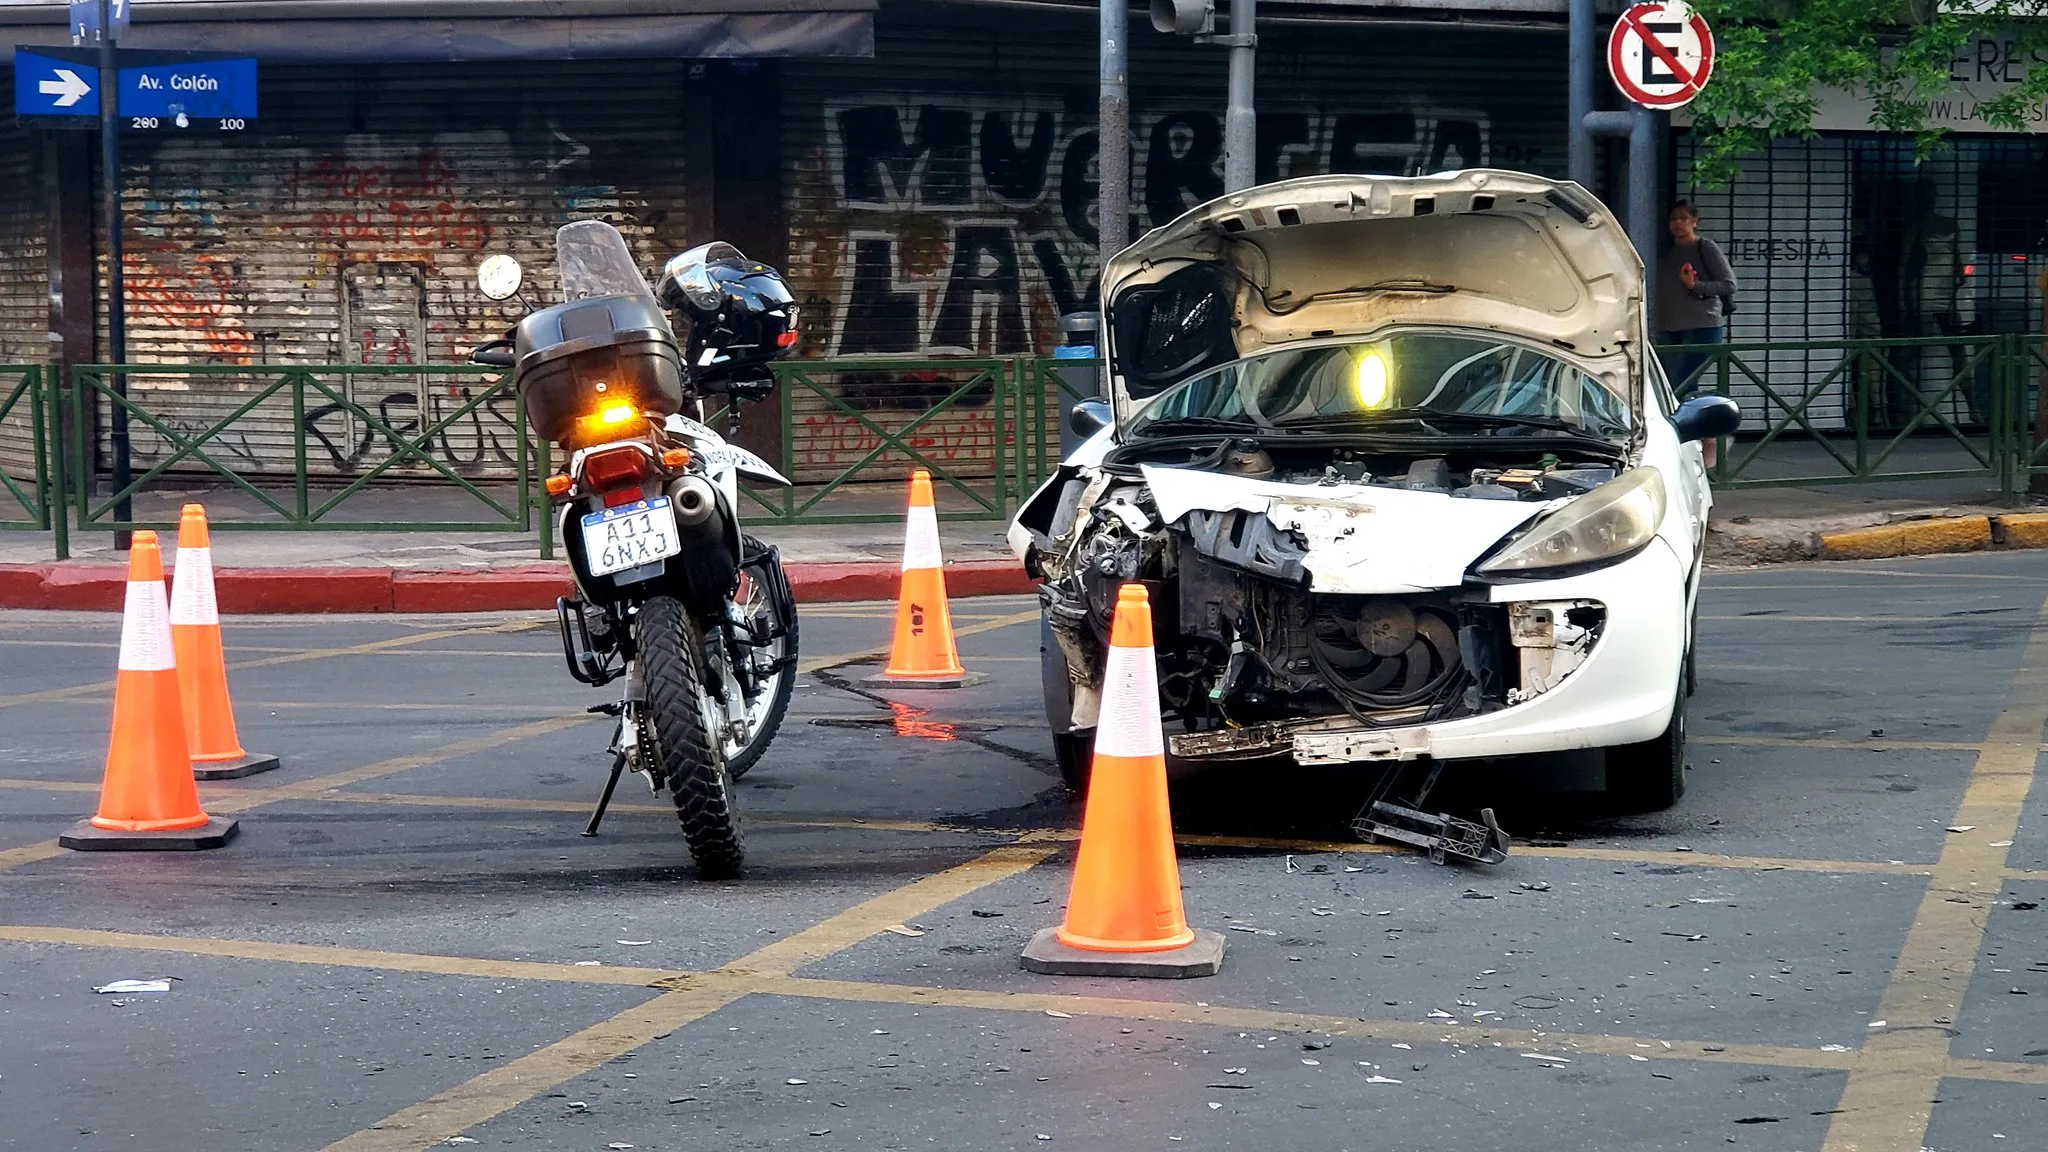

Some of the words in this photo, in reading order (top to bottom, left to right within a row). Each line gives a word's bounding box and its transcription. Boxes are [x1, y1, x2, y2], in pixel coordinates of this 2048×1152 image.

[138, 74, 163, 89] Av.
[170, 73, 218, 91] Colón
[220, 118, 245, 130] 100
[607, 513, 655, 543] A11
[602, 533, 668, 567] 6NXJ
